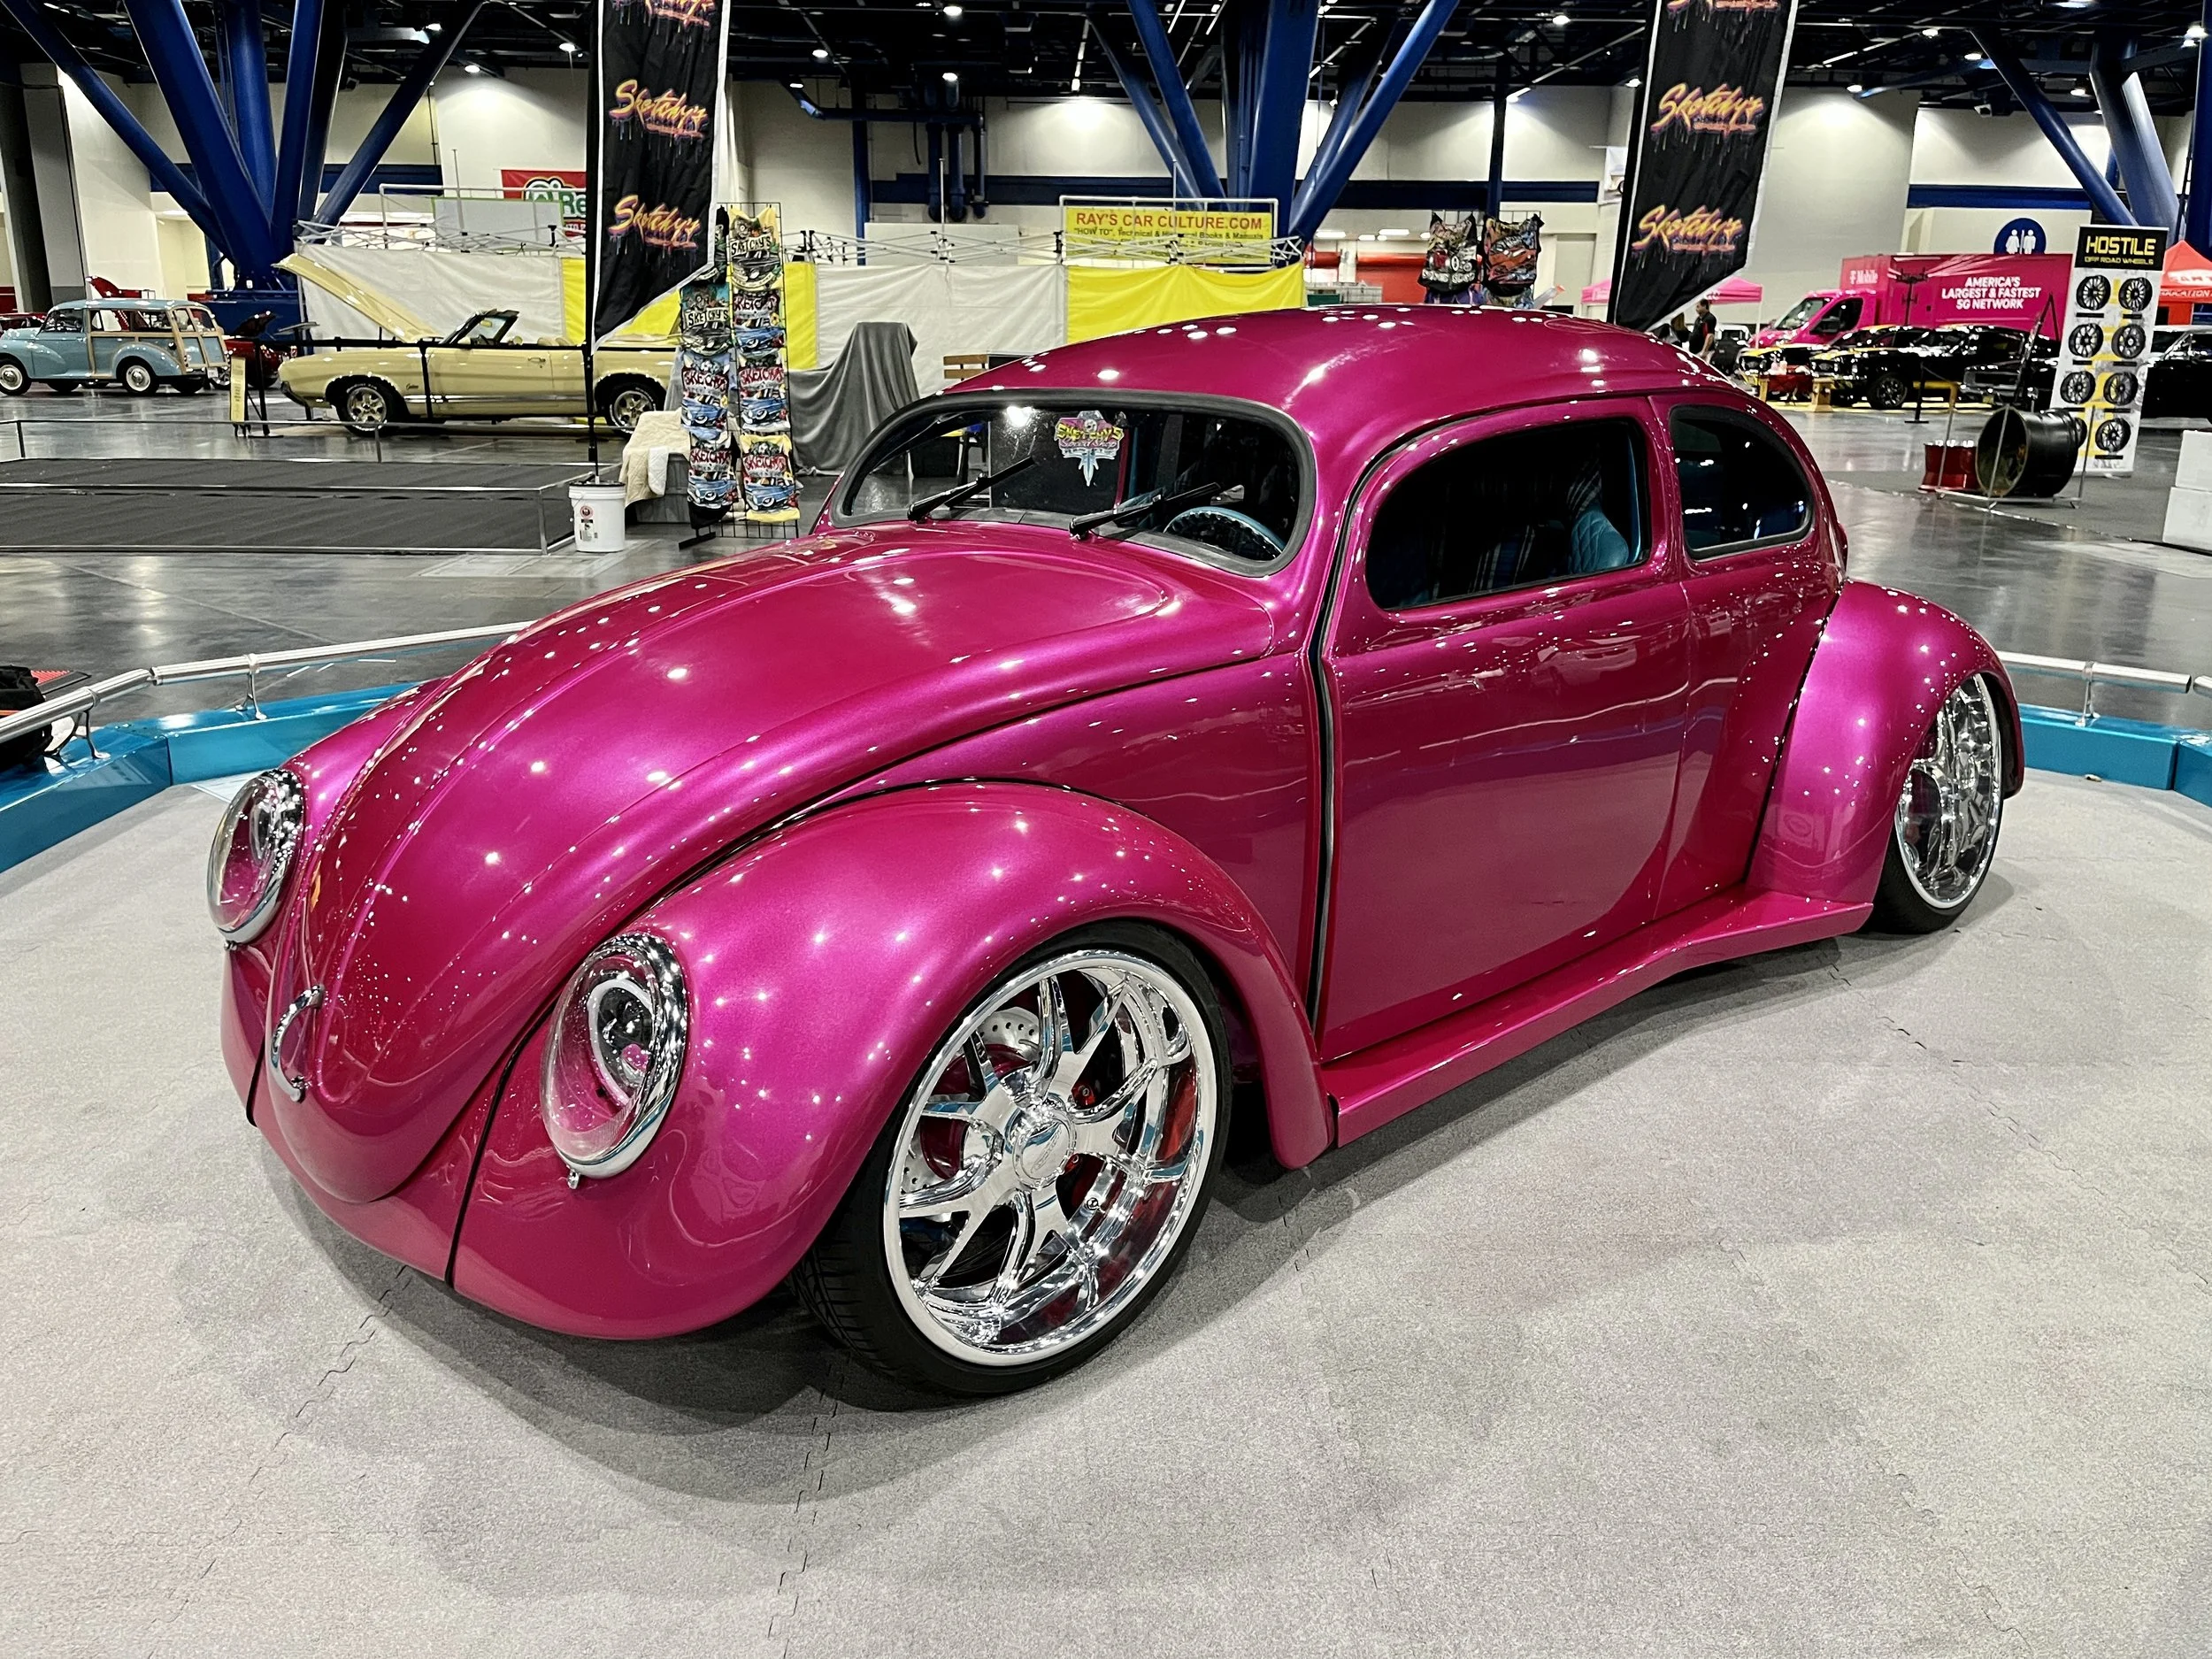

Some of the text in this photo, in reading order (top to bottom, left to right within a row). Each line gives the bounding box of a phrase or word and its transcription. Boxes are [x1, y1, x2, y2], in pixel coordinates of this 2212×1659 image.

[1076, 212, 1262, 230] RAY'S CAR CULTURE.COM
[2085, 235, 2156, 256] HOSTILE
[1964, 276, 2021, 288] AMERICA'S
[1941, 287, 2042, 299] LARGEST & FASTEST
[1955, 298, 2024, 310] 5G NETWORK
